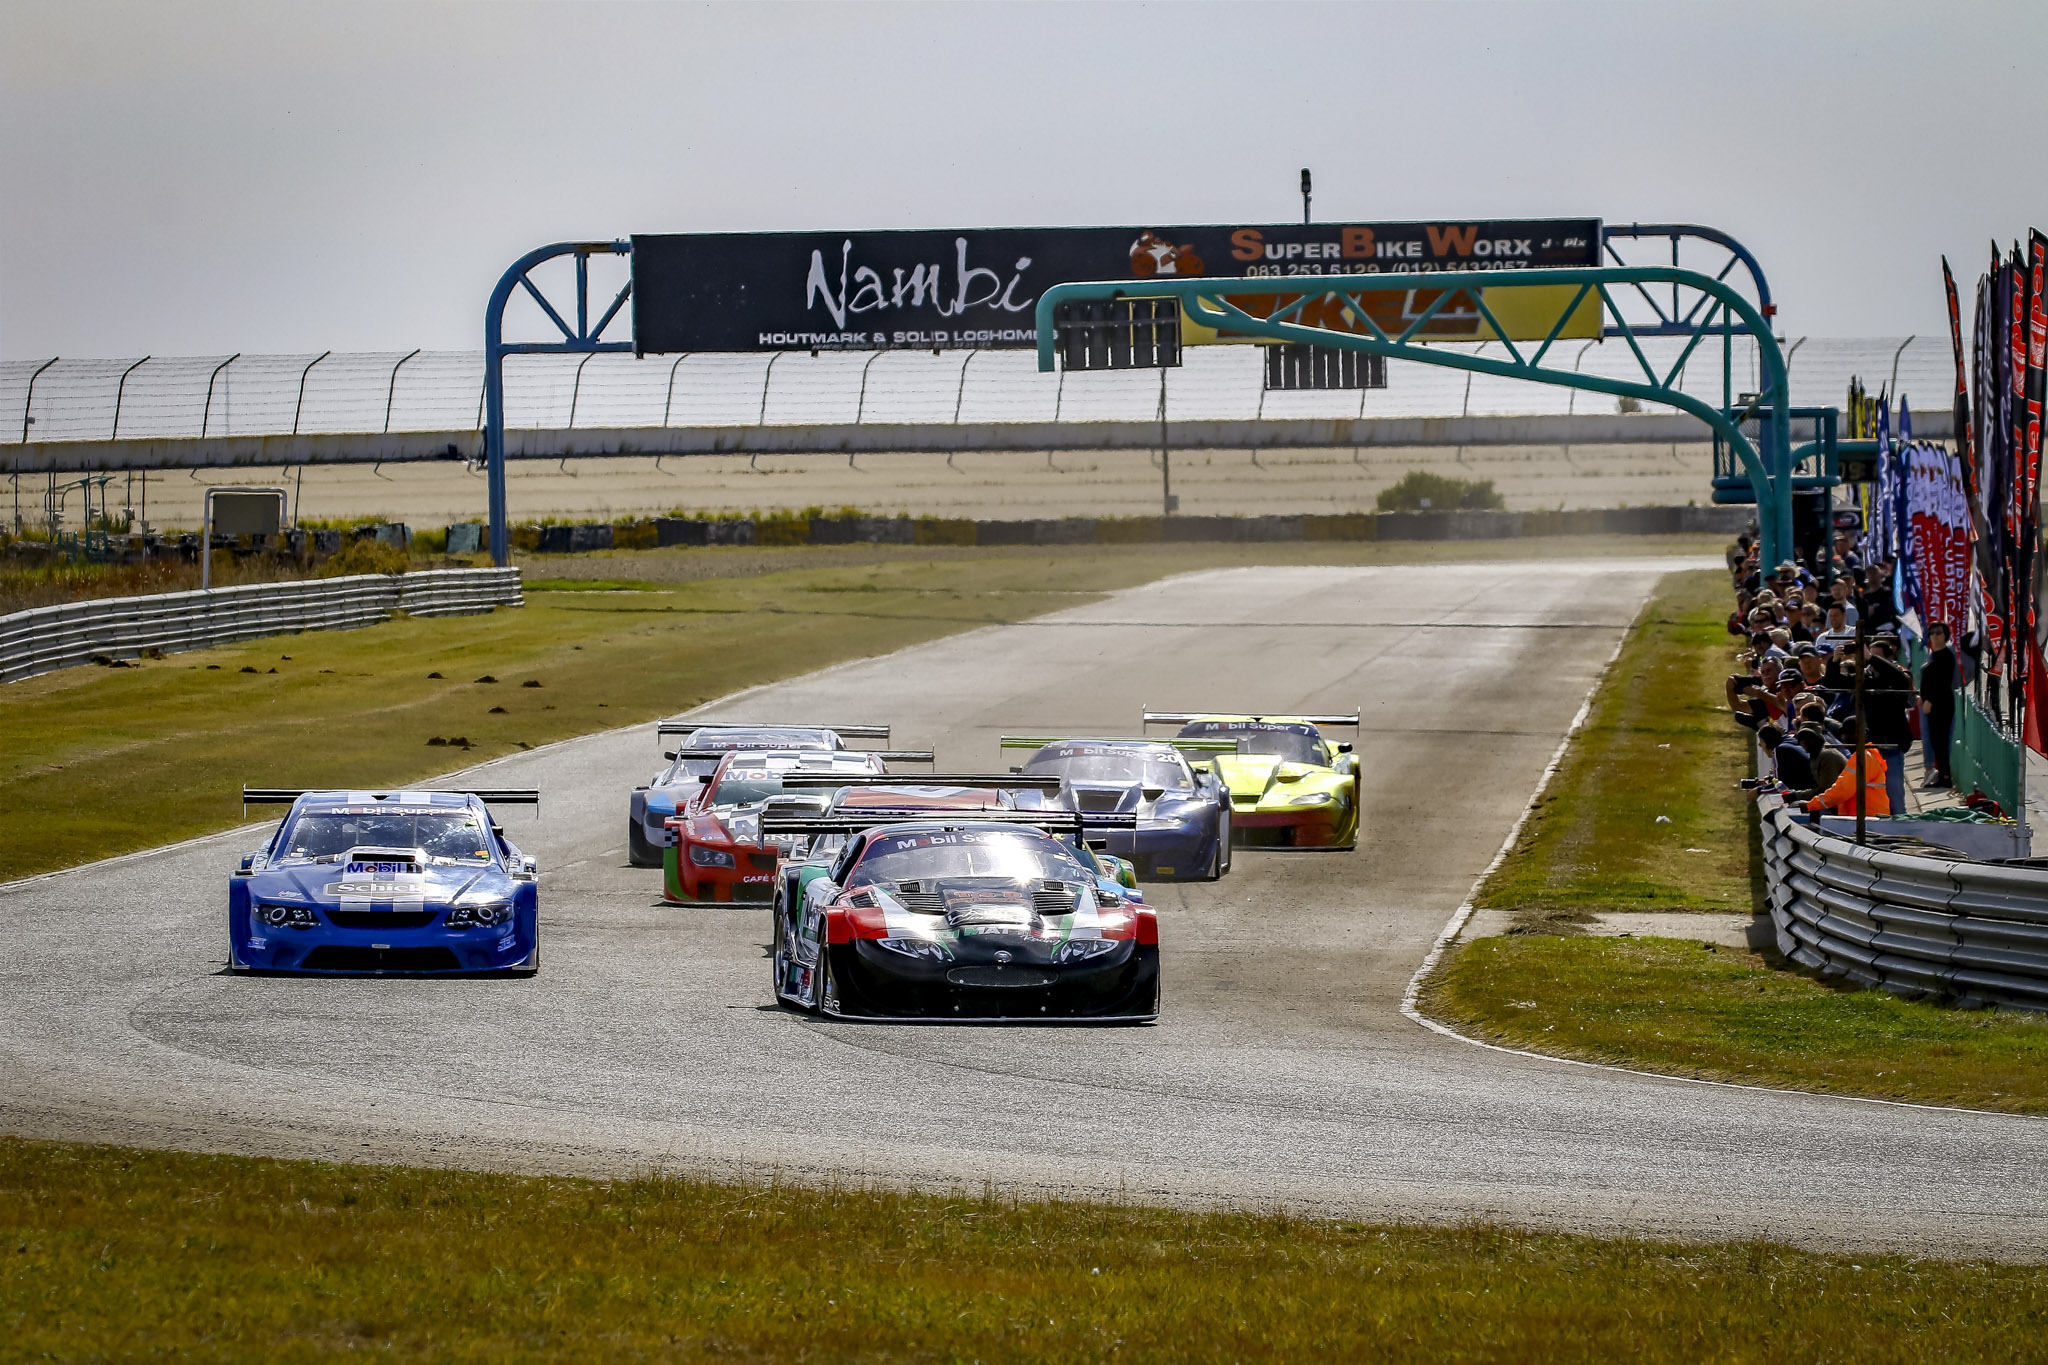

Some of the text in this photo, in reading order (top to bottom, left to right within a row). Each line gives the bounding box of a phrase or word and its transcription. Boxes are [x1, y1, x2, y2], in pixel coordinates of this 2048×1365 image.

[1287, 263, 1322, 275] 253
[806, 236, 1033, 330] Nambi
[759, 331, 867, 345] HOUTMARK
[873, 332, 886, 343] &
[893, 331, 949, 344] SOLID
[1251, 721, 1292, 731] Super
[725, 770, 782, 781] Mob
[896, 834, 958, 850] Mobil
[346, 862, 401, 874] Mobil
[743, 874, 770, 883] CAFÉ
